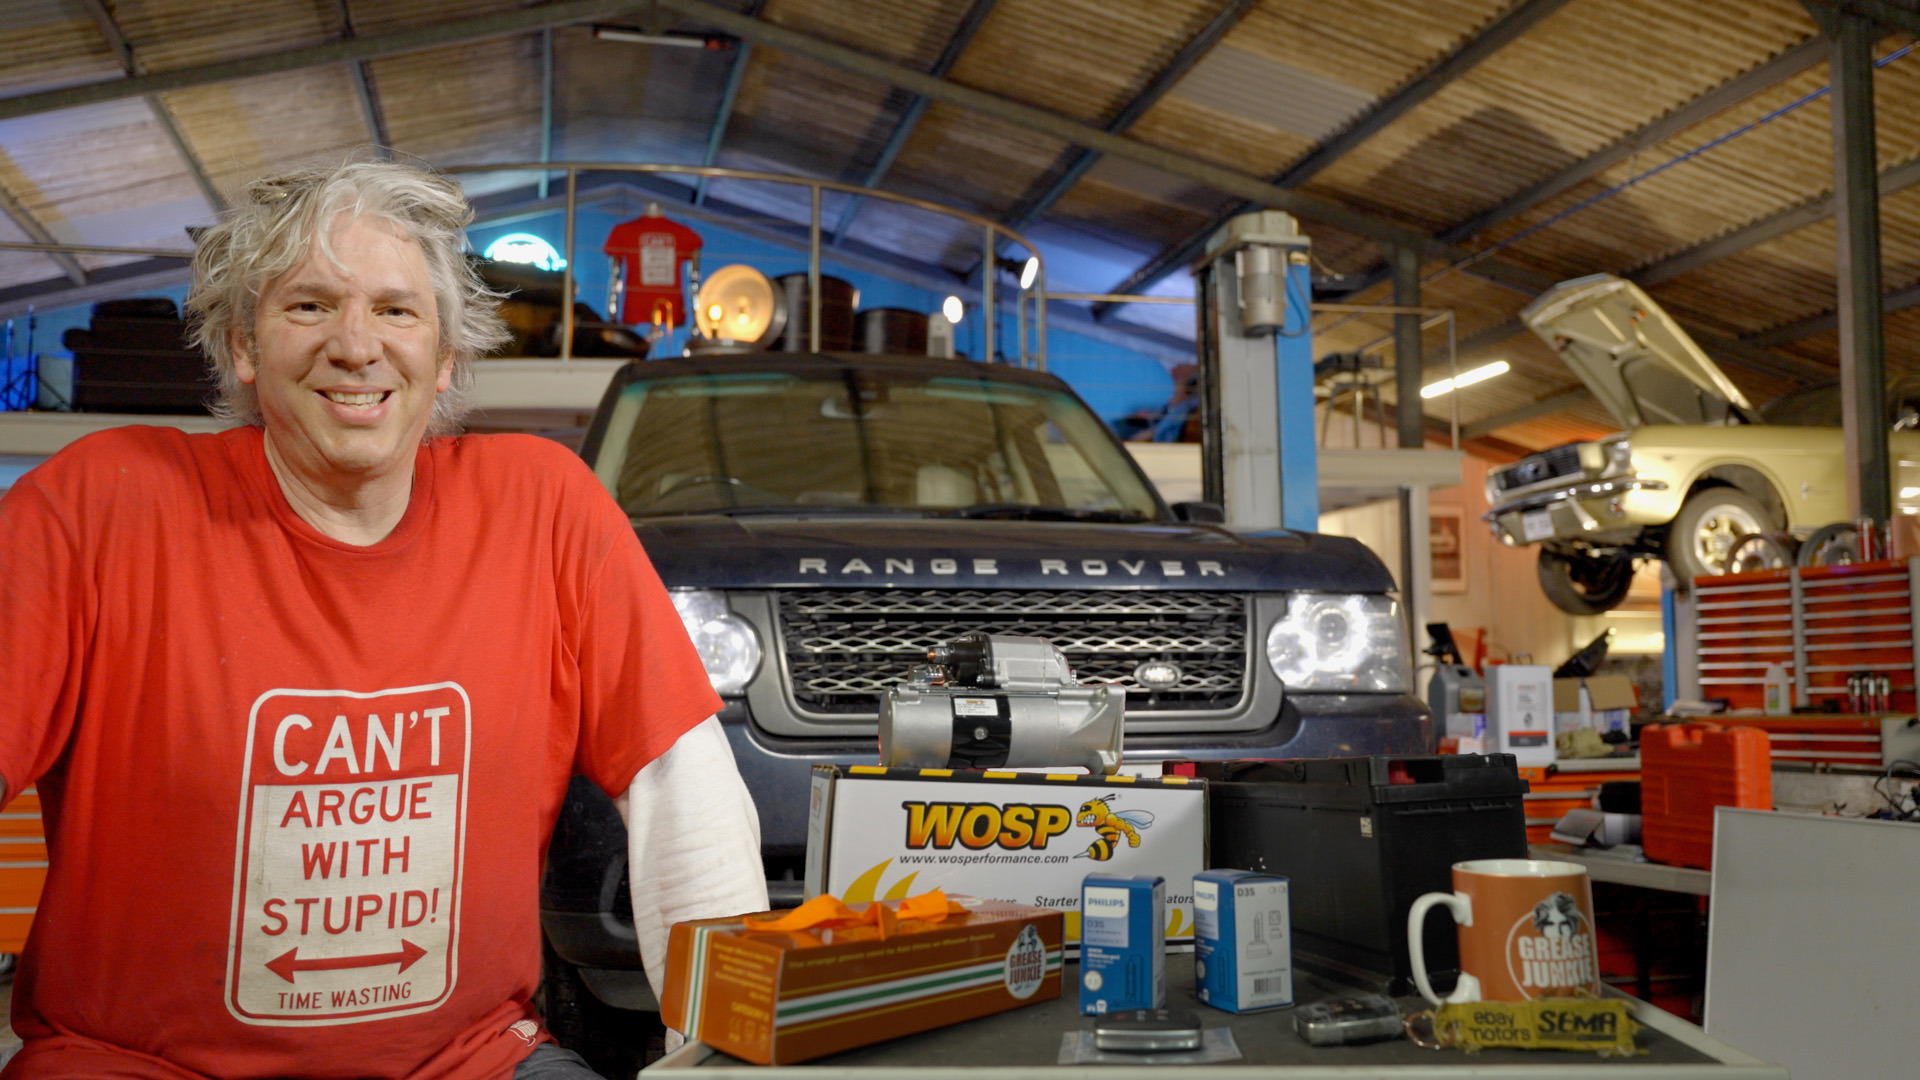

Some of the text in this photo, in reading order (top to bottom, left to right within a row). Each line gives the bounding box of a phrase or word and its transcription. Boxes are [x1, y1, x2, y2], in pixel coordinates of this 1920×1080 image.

[799, 558, 1226, 577] RANGE ROVER
[273, 707, 450, 776] CAN'T
[280, 781, 432, 828] ARGUE
[902, 801, 1072, 850] WOSP
[301, 836, 410, 880] WITH
[900, 853, 1069, 866] www.wosperformance.com
[1034, 896, 1078, 907] Starter
[1088, 897, 1125, 907] PHILIPS
[1237, 887, 1255, 897] D3S
[260, 888, 439, 936] STUPID!
[1010, 950, 1042, 968] GREASE
[1518, 933, 1592, 960] GREASE
[1009, 965, 1042, 986] JUNKIE
[1522, 957, 1593, 987] JUNKIE
[278, 982, 412, 1009] TIME WASTING
[1537, 1010, 1617, 1033] SEMA
